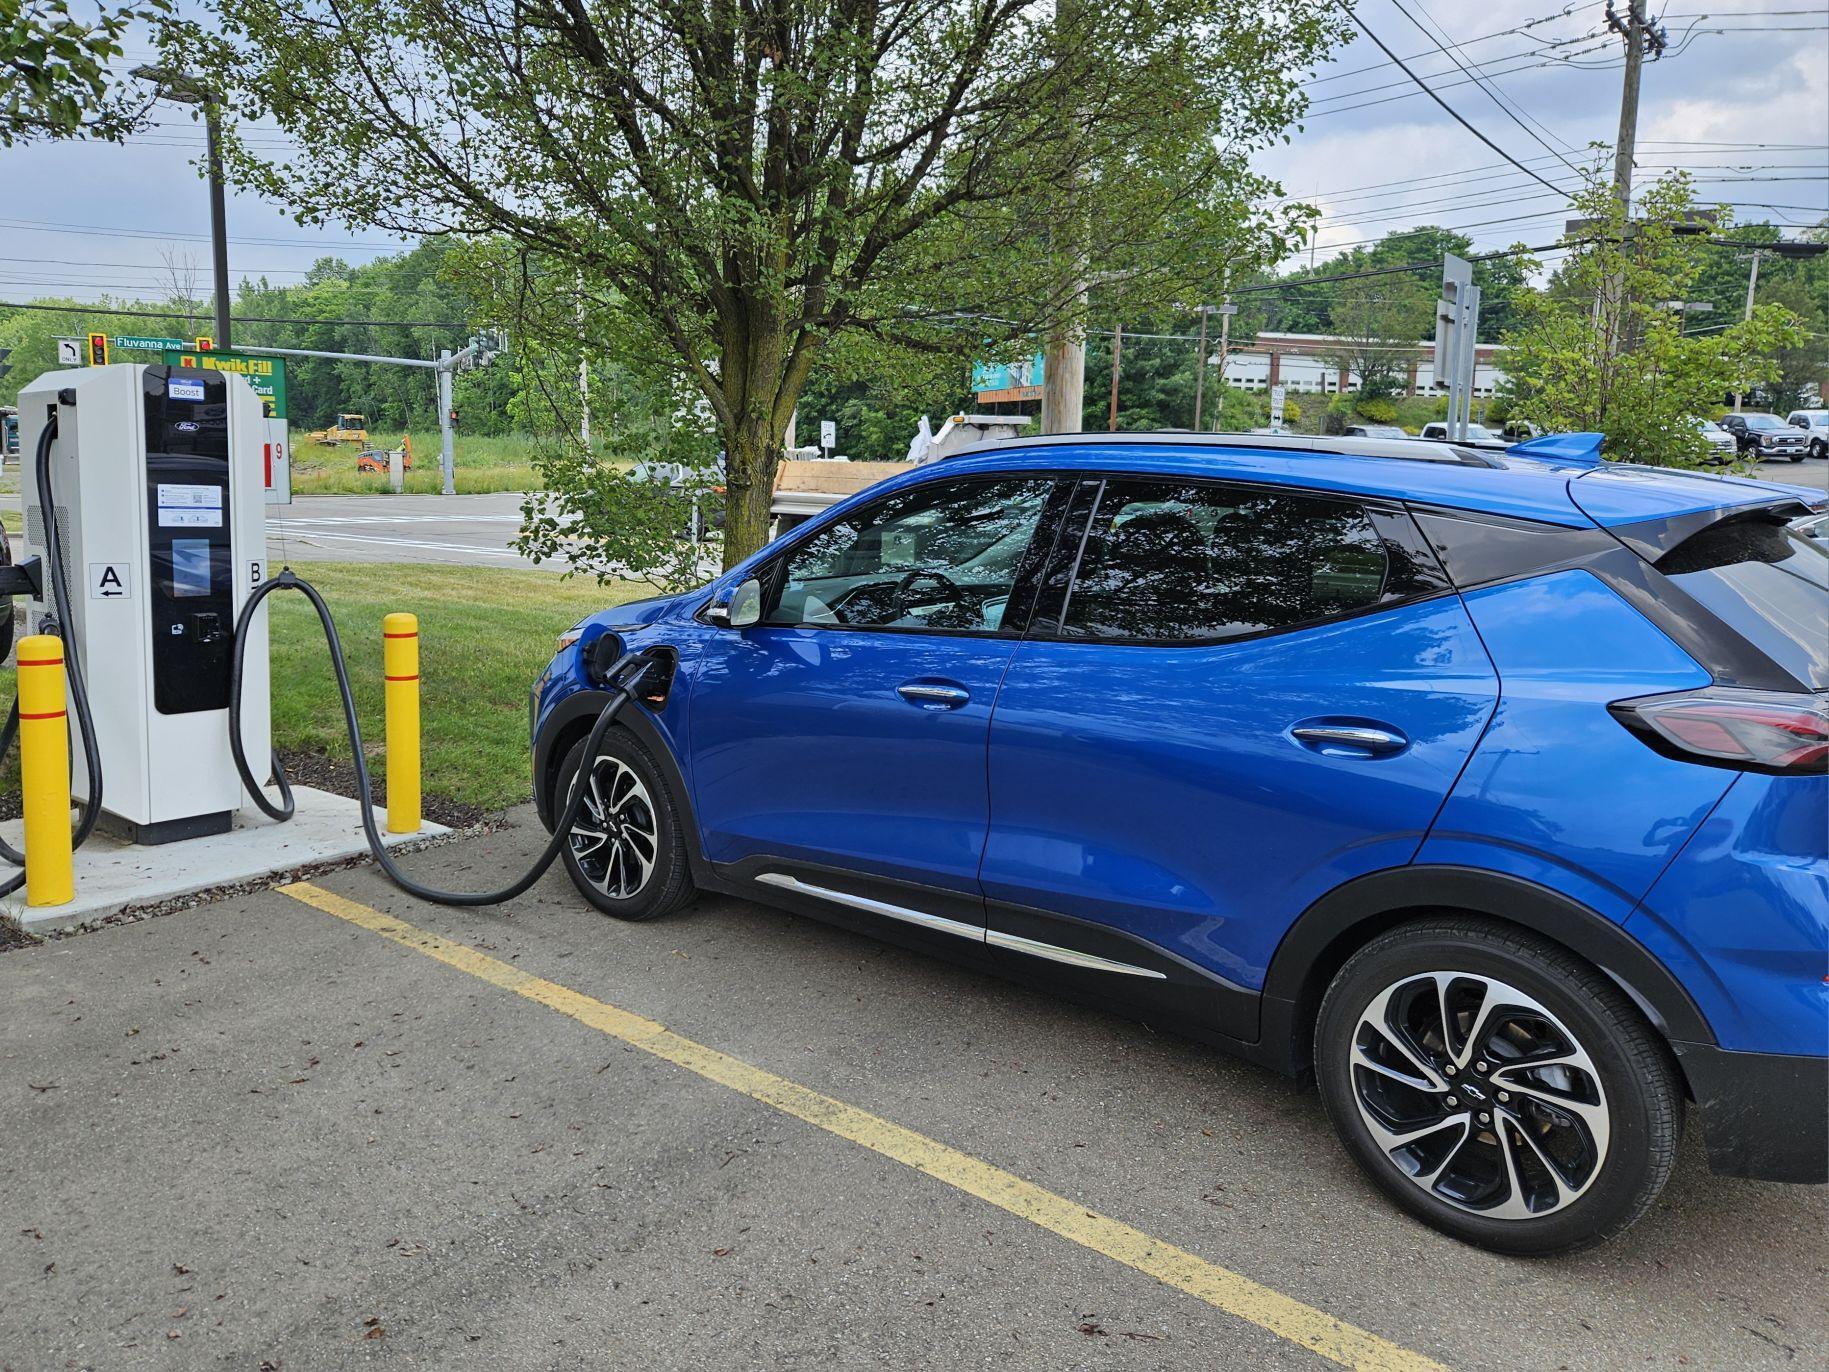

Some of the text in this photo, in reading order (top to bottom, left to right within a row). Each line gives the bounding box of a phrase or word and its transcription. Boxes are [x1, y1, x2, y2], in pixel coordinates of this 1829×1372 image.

[117, 338, 181, 350] Fluvanna Ave
[173, 387, 200, 397] Boost
[276, 443, 282, 460] 9
[99, 566, 122, 588] A
[251, 562, 261, 583] B
